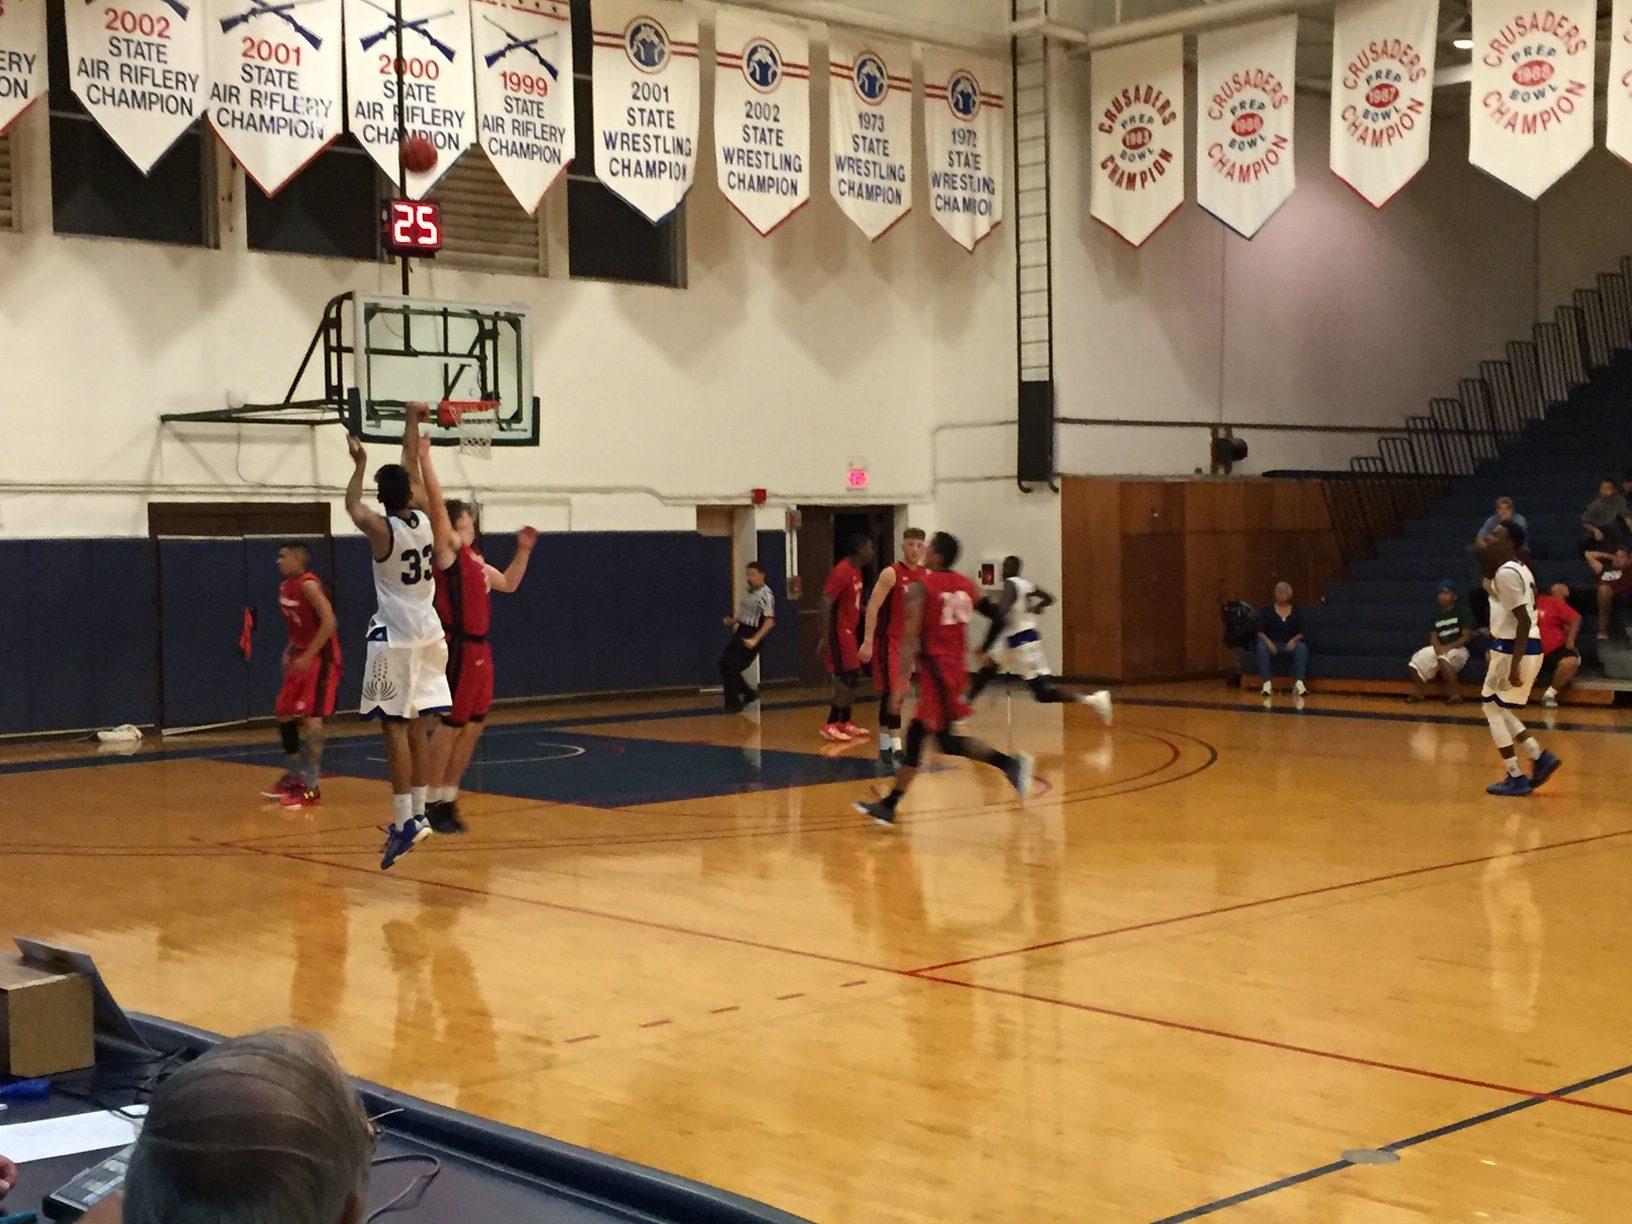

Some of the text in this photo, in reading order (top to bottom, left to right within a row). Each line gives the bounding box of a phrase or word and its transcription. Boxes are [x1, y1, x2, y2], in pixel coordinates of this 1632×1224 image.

[104, 8, 171, 40] 2002
[108, 36, 168, 64] STATE
[242, 37, 301, 66] 2001
[1483, 10, 1587, 68] CRUSADERS
[378, 54, 440, 81] 2000
[1343, 38, 1427, 90] CRUSADERS
[1511, 45, 1556, 63] PREP
[77, 57, 199, 92] AIR RIFLERY
[241, 63, 299, 91] STATE
[500, 70, 548, 97] 1999
[1365, 69, 1402, 86] PREP
[86, 84, 194, 116] CHAMPION
[210, 82, 241, 105] AIR
[383, 79, 436, 103] SATE
[631, 81, 669, 103] 2001
[1208, 68, 1289, 120] CRUSADERS
[1509, 83, 1558, 103] BOWL
[355, 101, 384, 121] AIR
[504, 95, 545, 119] STATE
[627, 107, 675, 129] STATE
[744, 101, 780, 122] 2002
[1099, 84, 1177, 135] CRUSADERS
[1230, 99, 1266, 116] PREP
[1362, 105, 1401, 123] BOWL
[1482, 79, 1586, 135] CHAMPION
[216, 107, 324, 140] CHAMPION
[482, 114, 565, 144] AIR RIFLERY
[858, 112, 885, 133] 1973
[1121, 113, 1154, 129] PREP
[1341, 98, 1425, 148] CHAMPION
[603, 131, 692, 157] WRESTLING
[742, 125, 783, 147] STATE
[852, 135, 889, 157] STATE
[1228, 134, 1266, 151] BOWL
[488, 137, 561, 165] CHAMPION
[723, 146, 802, 173] WRESTLING
[1120, 147, 1154, 163] BOWL
[1208, 134, 1288, 183] CHAMPION
[609, 157, 687, 181] CHAMPION
[835, 155, 906, 183] WRESTLING
[1101, 148, 1173, 191] CHAMPION
[727, 171, 798, 196] CHAMPION
[838, 178, 902, 205] CHAMPION
[394, 204, 438, 245] 25
[401, 544, 433, 585] 33
